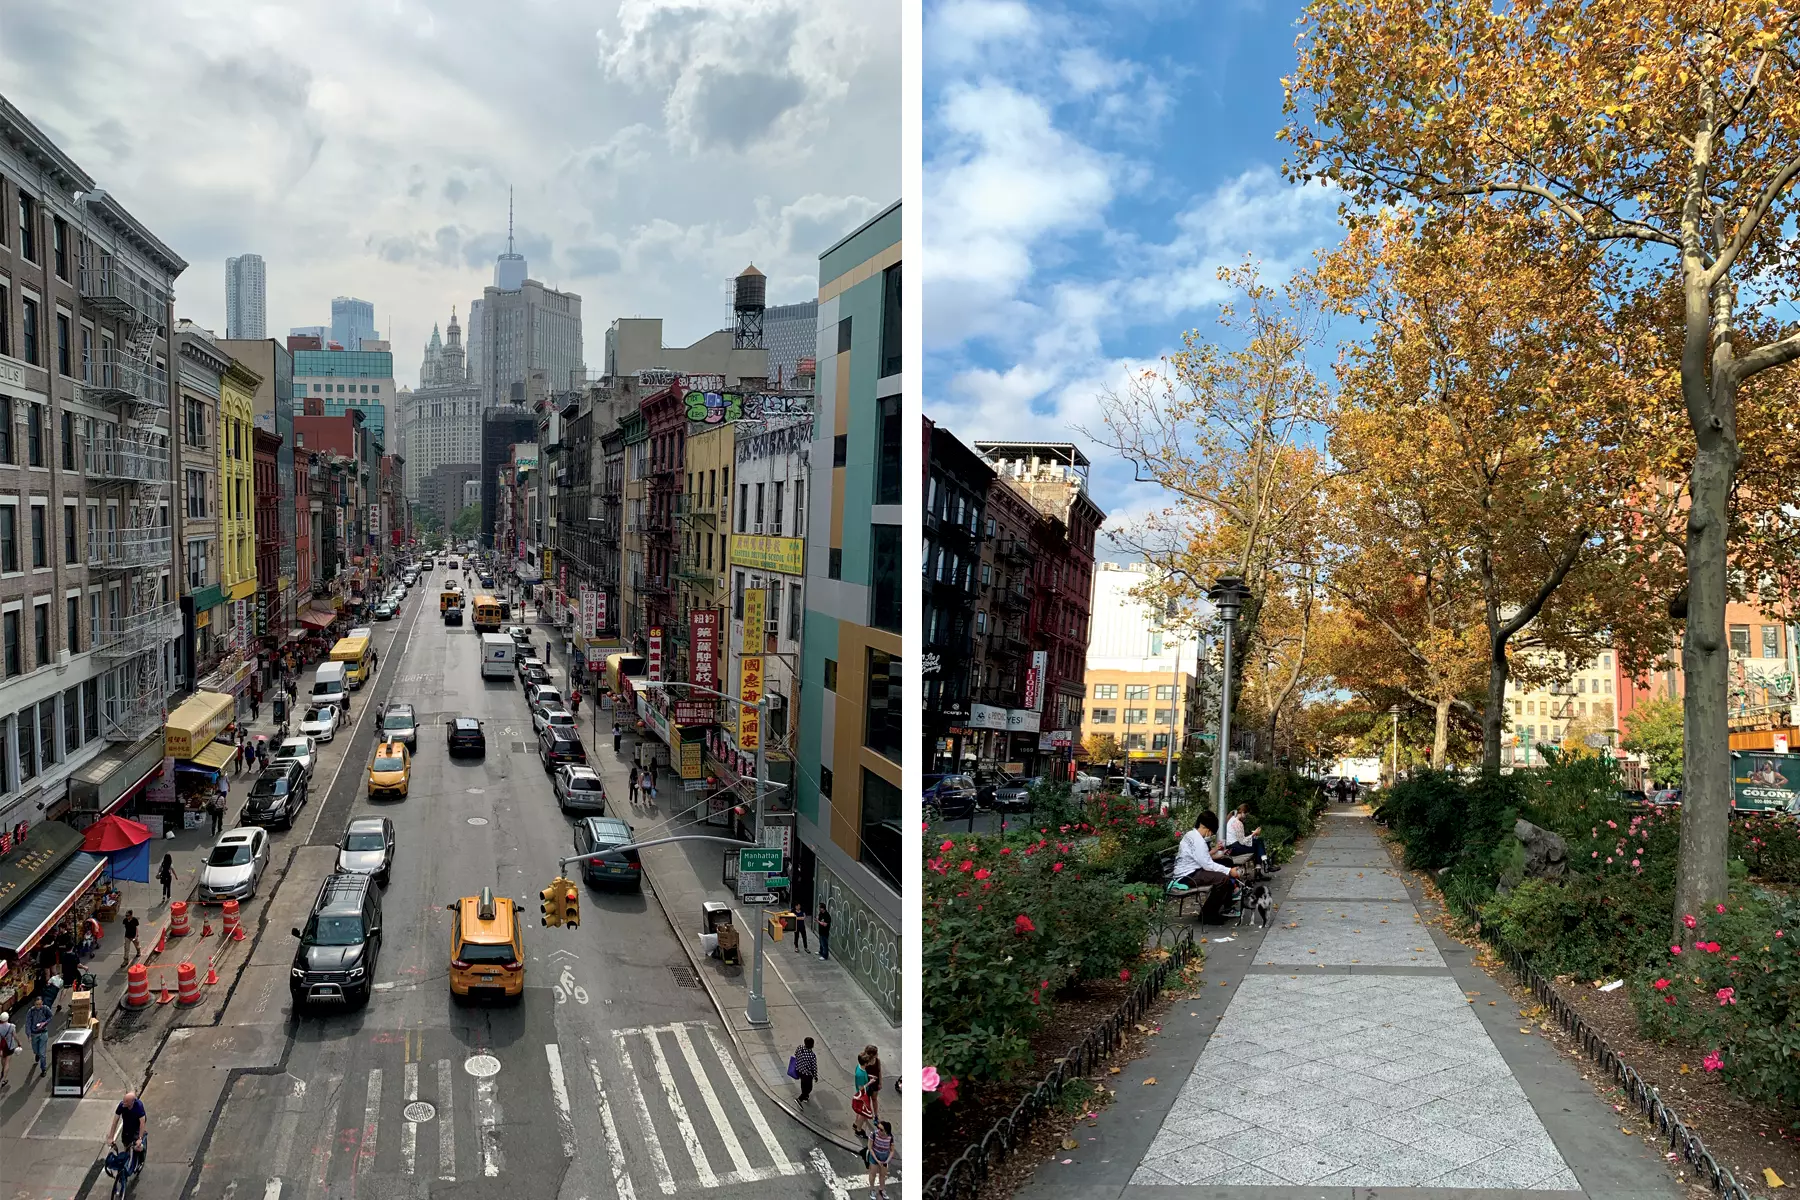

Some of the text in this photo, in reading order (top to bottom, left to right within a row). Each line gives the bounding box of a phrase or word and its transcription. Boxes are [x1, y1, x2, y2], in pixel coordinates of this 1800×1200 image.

[650, 629, 661, 637] 66
[1024, 669, 1035, 708] LIQUORS
[1006, 716, 1023, 725] YES!
[1742, 789, 1795, 798] COLONY
